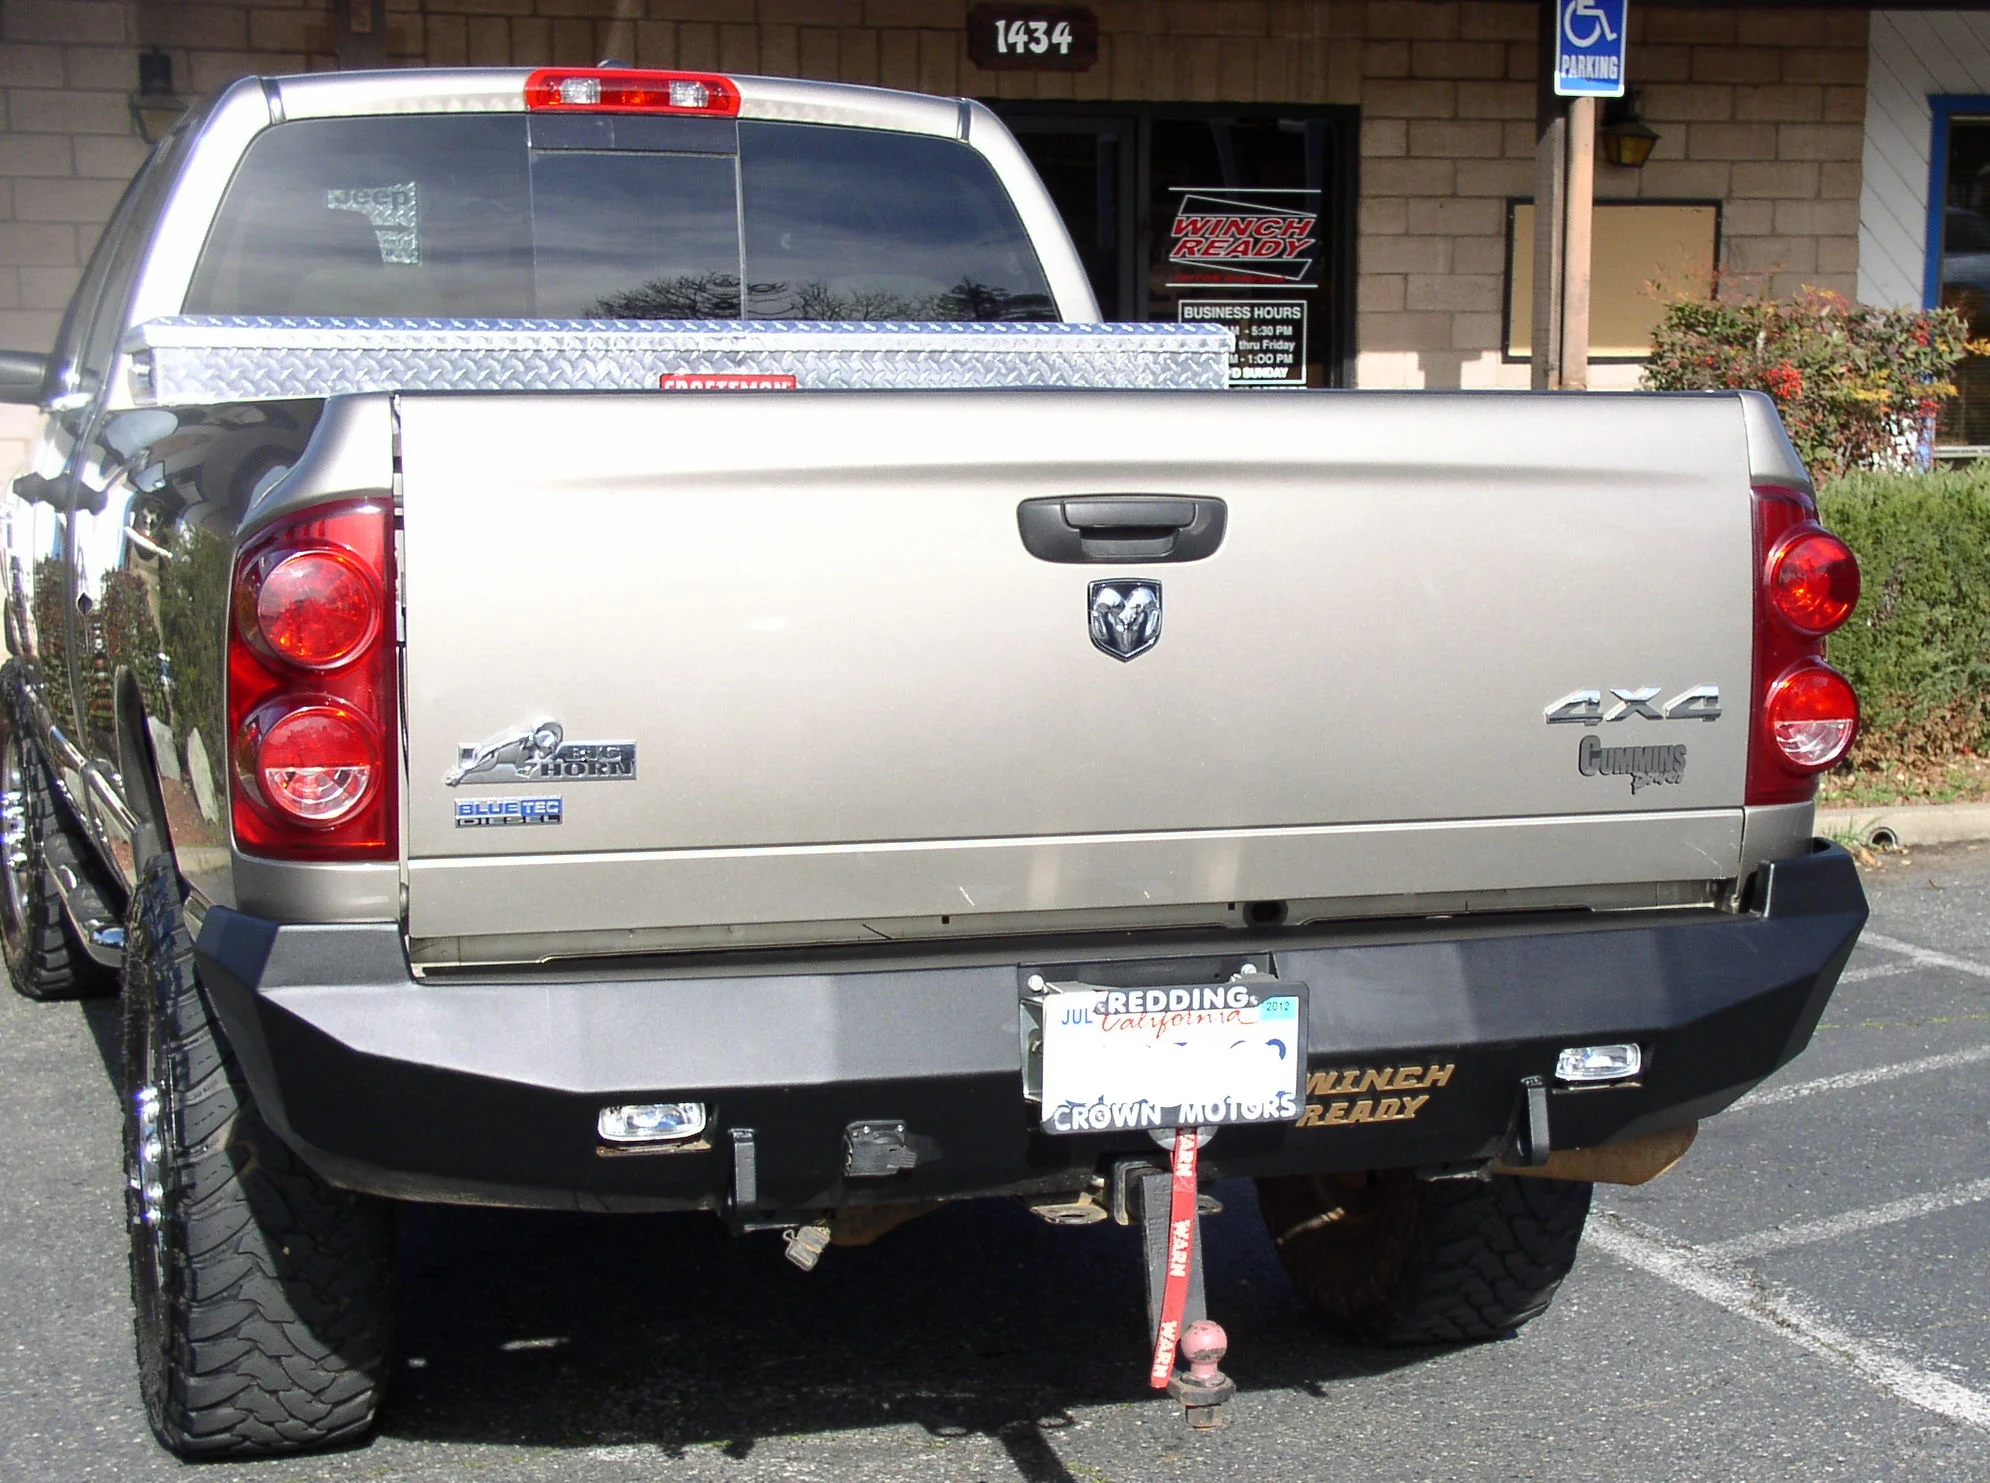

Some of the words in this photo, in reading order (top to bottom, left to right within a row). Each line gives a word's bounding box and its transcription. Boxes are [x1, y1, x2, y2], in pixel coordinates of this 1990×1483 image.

[995, 20, 1073, 54] 1434
[1561, 54, 1619, 79] PARKING
[1171, 216, 1315, 237] WINCH
[1169, 237, 1316, 258] READY
[1183, 306, 1251, 319] BUSINESS
[1254, 306, 1301, 319] HOURS
[1251, 325, 1274, 336] 5:30
[1275, 325, 1293, 336] PM
[1238, 340, 1260, 350] thru
[1262, 340, 1296, 352] Friday
[1275, 353, 1293, 364] PM
[540, 760, 635, 778] HORN
[1107, 985, 1250, 1014] REDDING
[1061, 1008, 1093, 1026] JUL
[1266, 1001, 1291, 1012] 2012
[1306, 1063, 1455, 1096] WINCH
[1052, 1101, 1162, 1131] CROWN
[1178, 1092, 1298, 1125] MOTORS
[1295, 1094, 1430, 1128] READY
[1175, 1132, 1196, 1177] ARN
[1169, 1218, 1191, 1277] WARN
[1152, 1320, 1178, 1378] WARN
